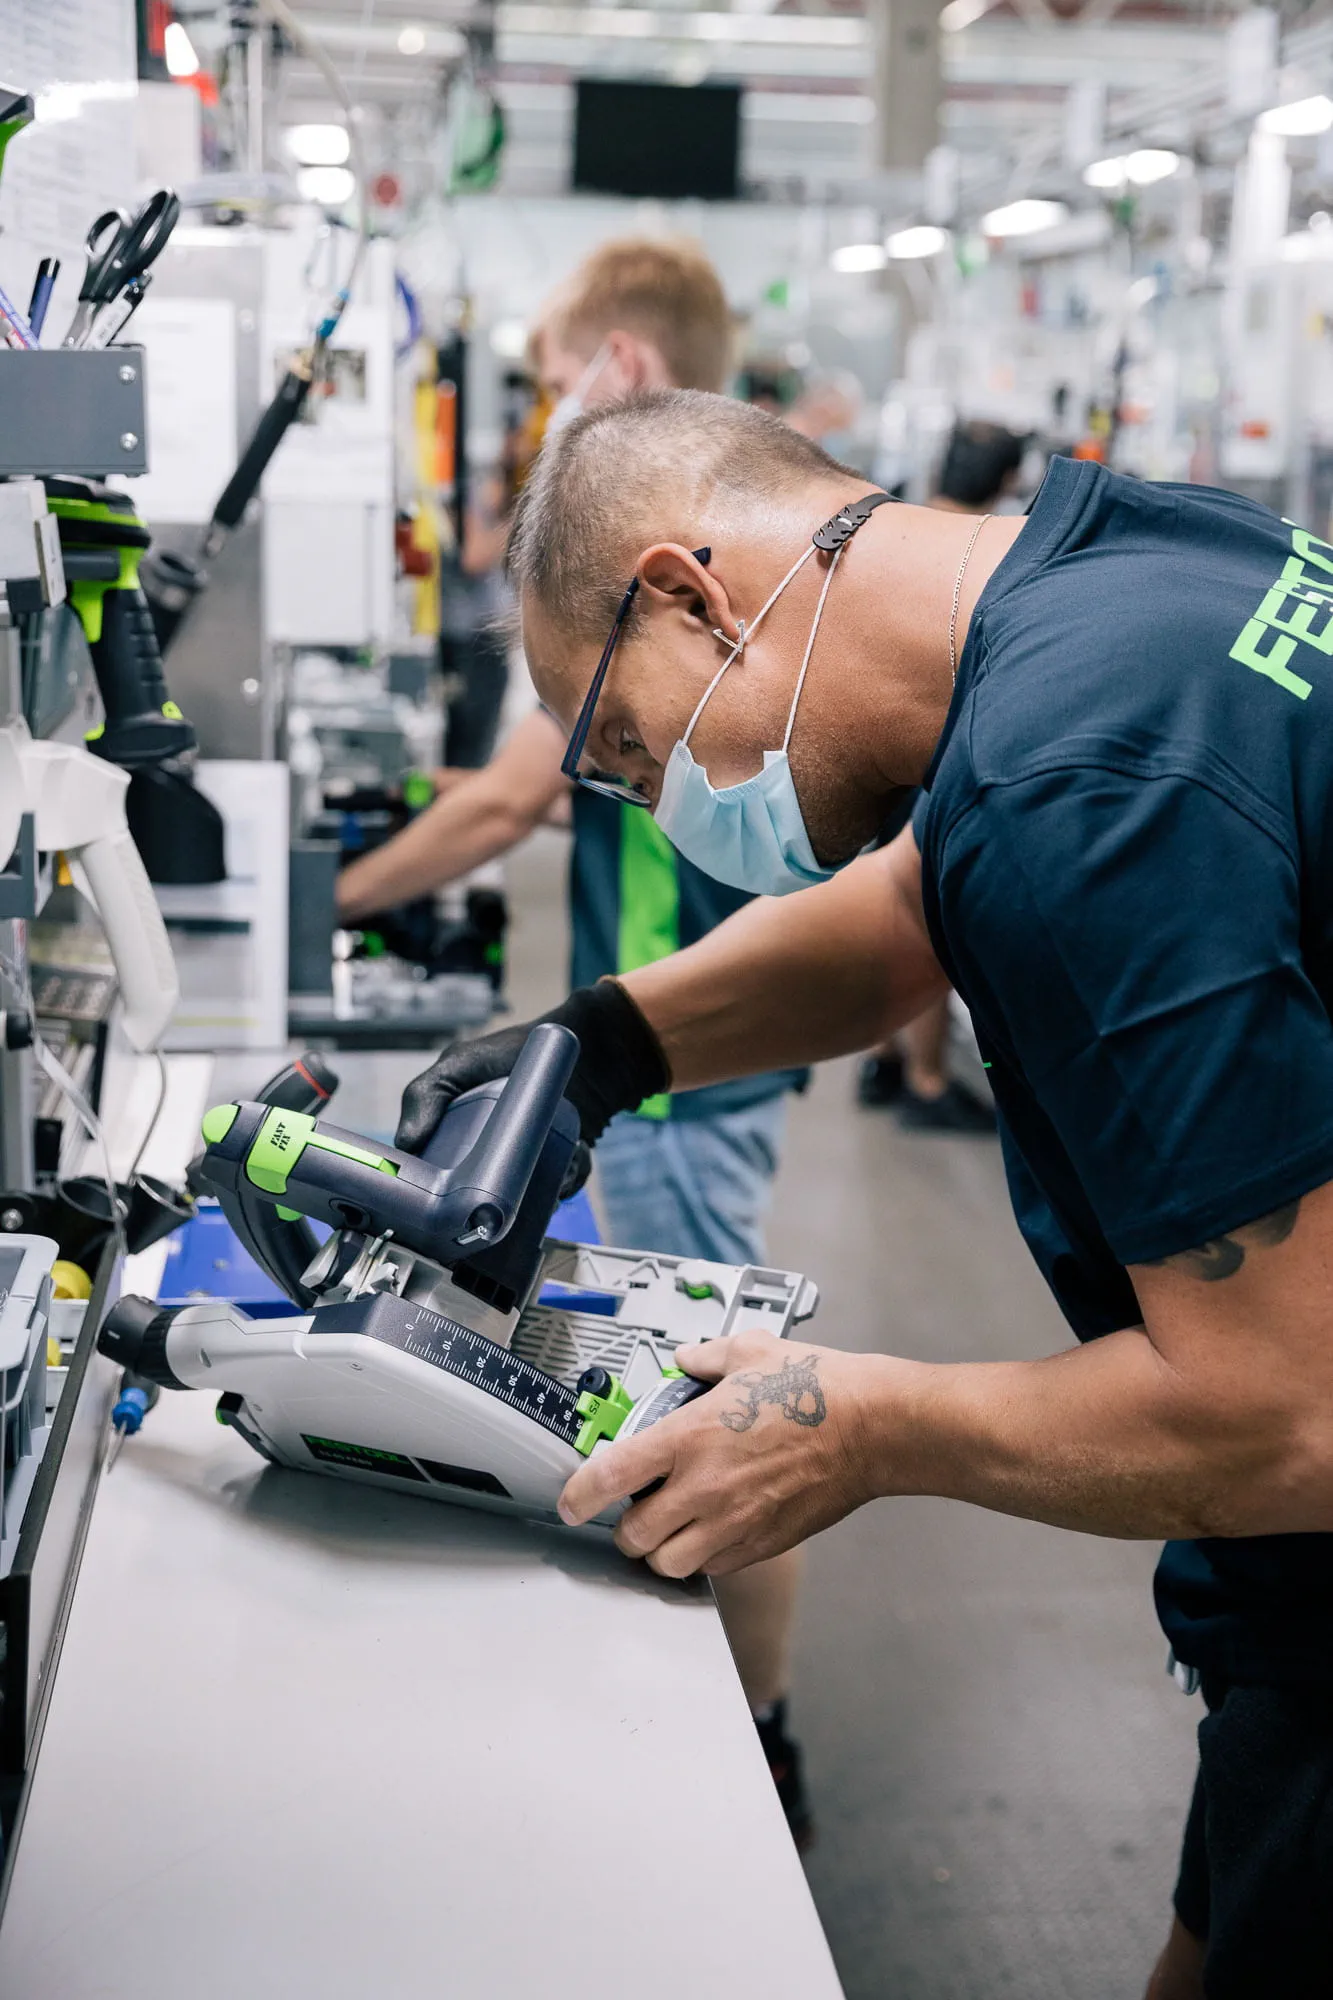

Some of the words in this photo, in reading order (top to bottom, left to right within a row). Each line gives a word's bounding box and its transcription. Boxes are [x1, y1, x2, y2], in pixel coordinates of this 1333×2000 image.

[405, 1323, 415, 1331] 0
[442, 1340, 452, 1351] 10
[476, 1356, 486, 1368] 20
[508, 1375, 518, 1386] 30
[536, 1392, 546, 1404] 40
[563, 1410, 573, 1421] 50
[588, 1400, 600, 1415] FS
